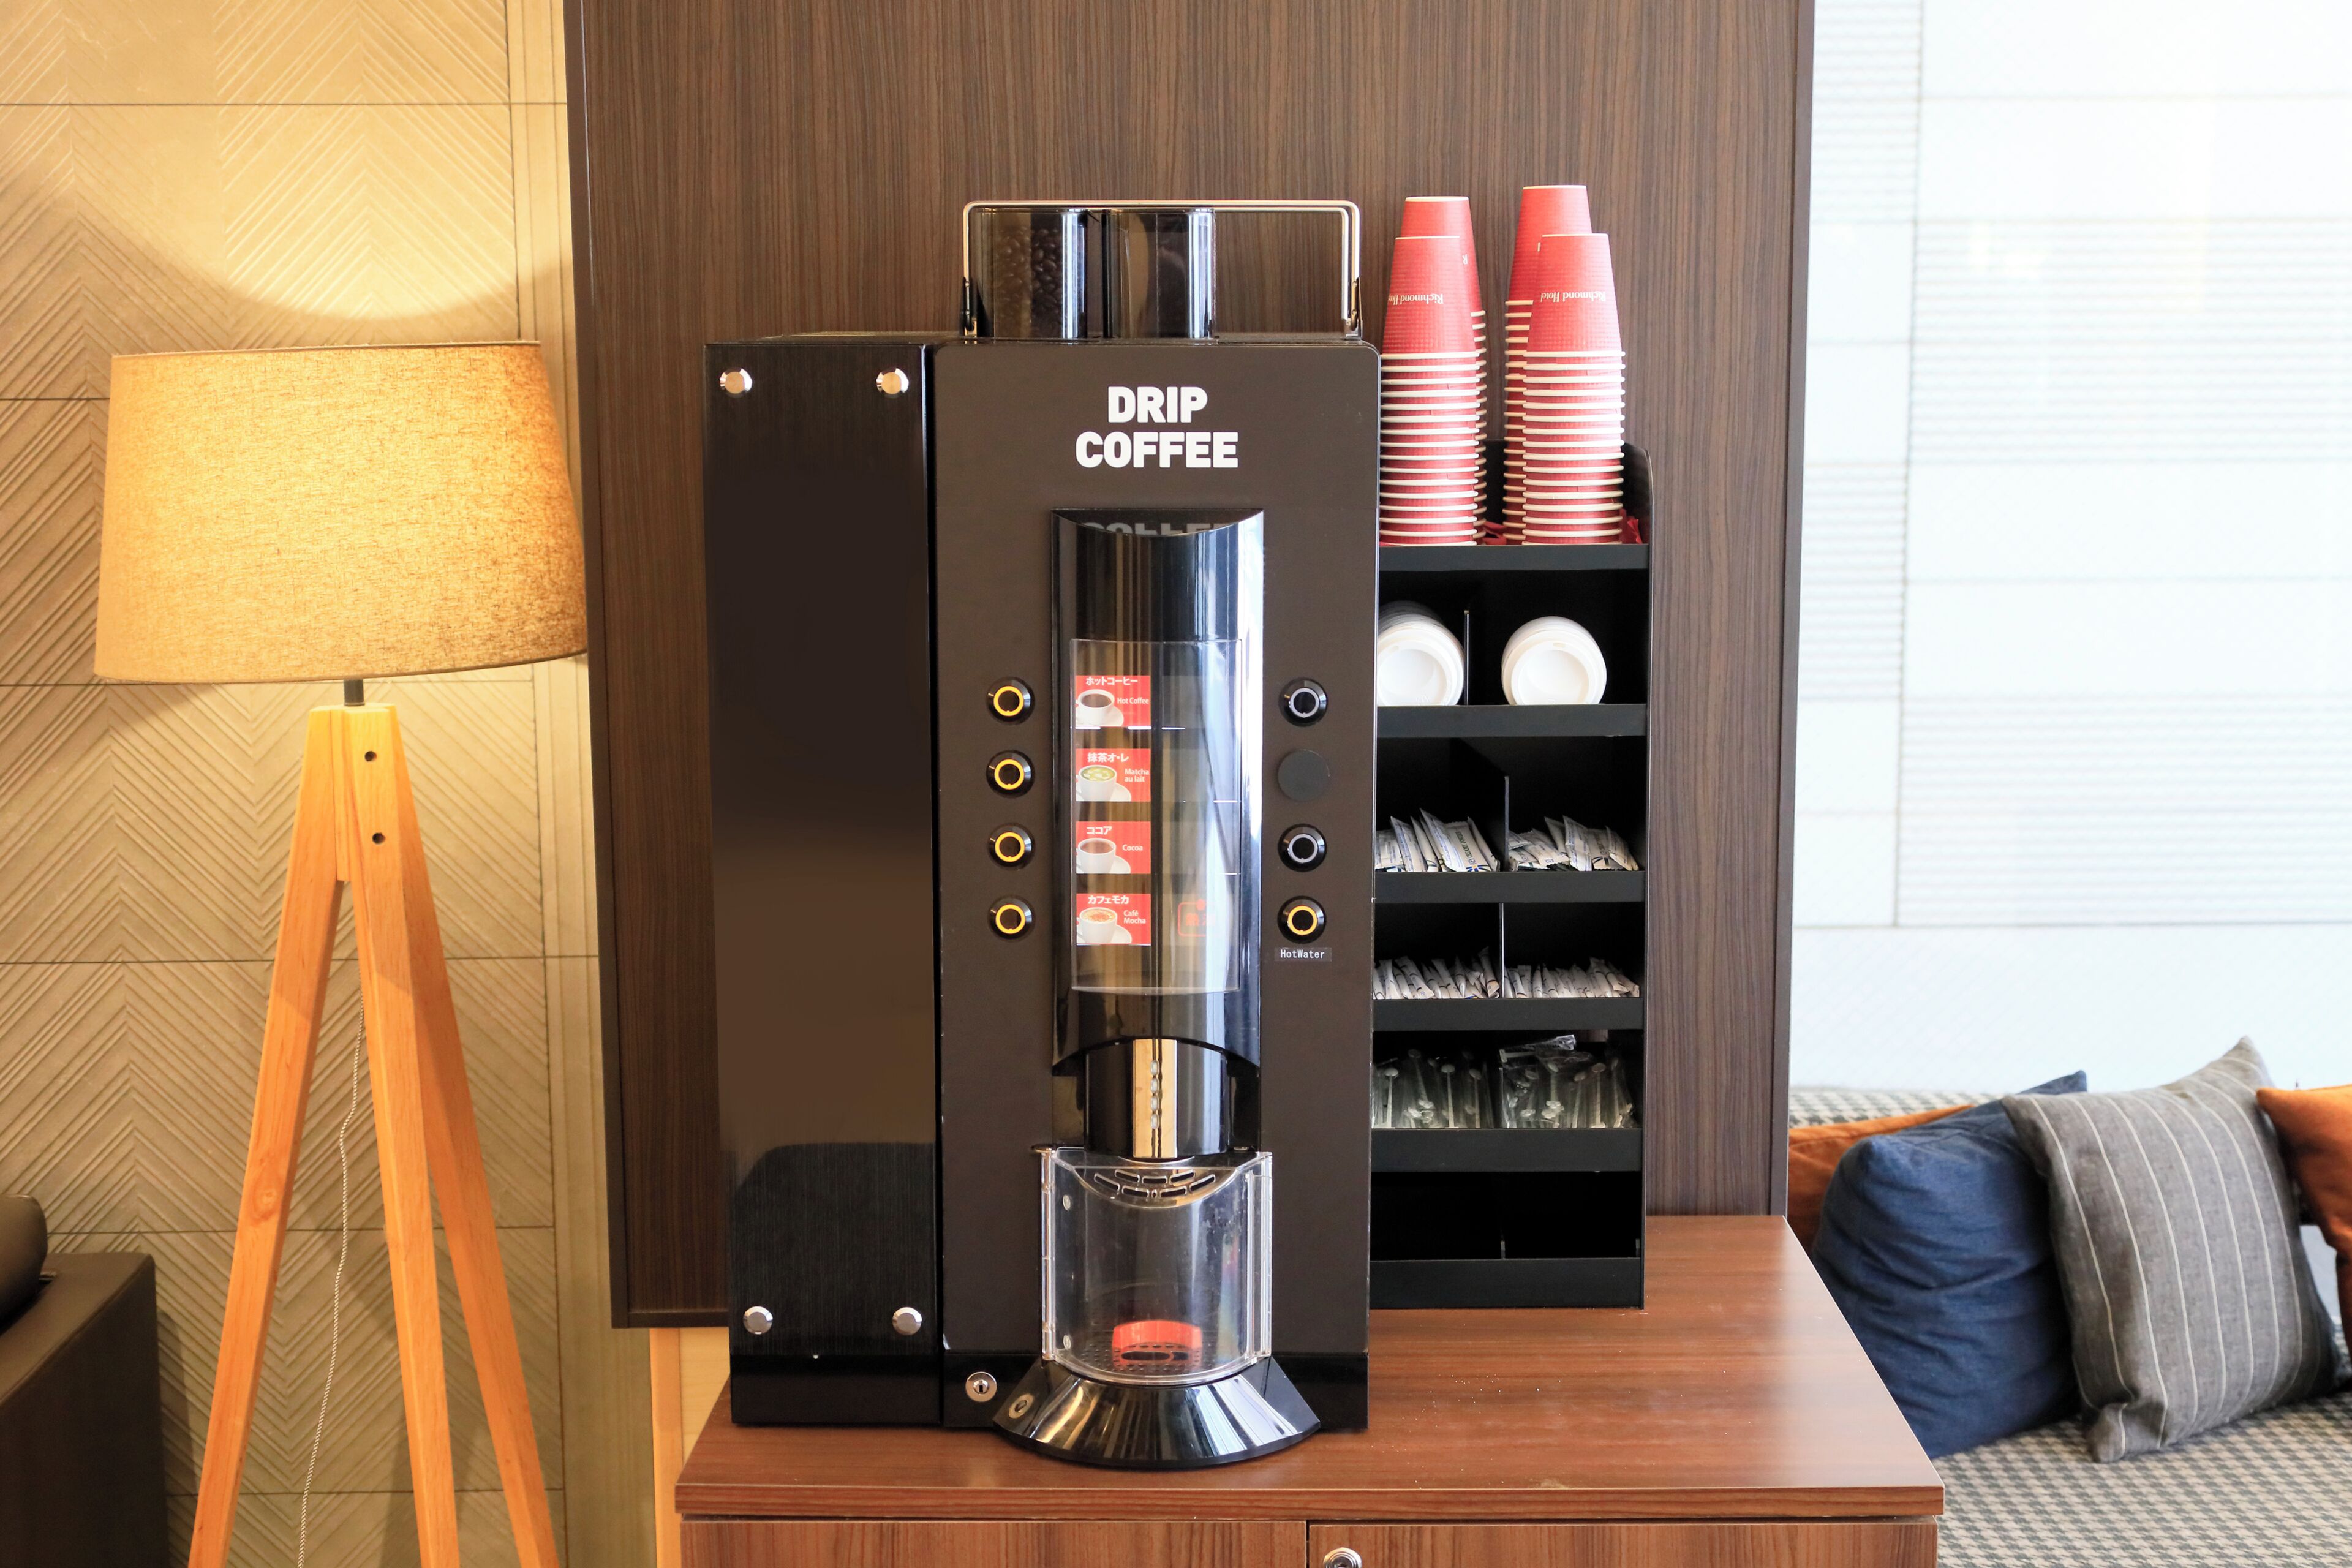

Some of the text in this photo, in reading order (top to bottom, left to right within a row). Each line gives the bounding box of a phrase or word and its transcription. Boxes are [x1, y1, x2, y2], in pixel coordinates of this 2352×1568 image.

[1400, 293, 1444, 304] Richmond
[1540, 291, 1607, 303] Richmond Hotel
[1107, 386, 1208, 423] DRIP
[1076, 431, 1238, 468] COFFEE
[1086, 676, 1138, 685] ホットコーヒー
[1087, 826, 1112, 835] ココア
[1088, 895, 1129, 904] カフェモカ
[1280, 949, 1325, 959] HotWater
